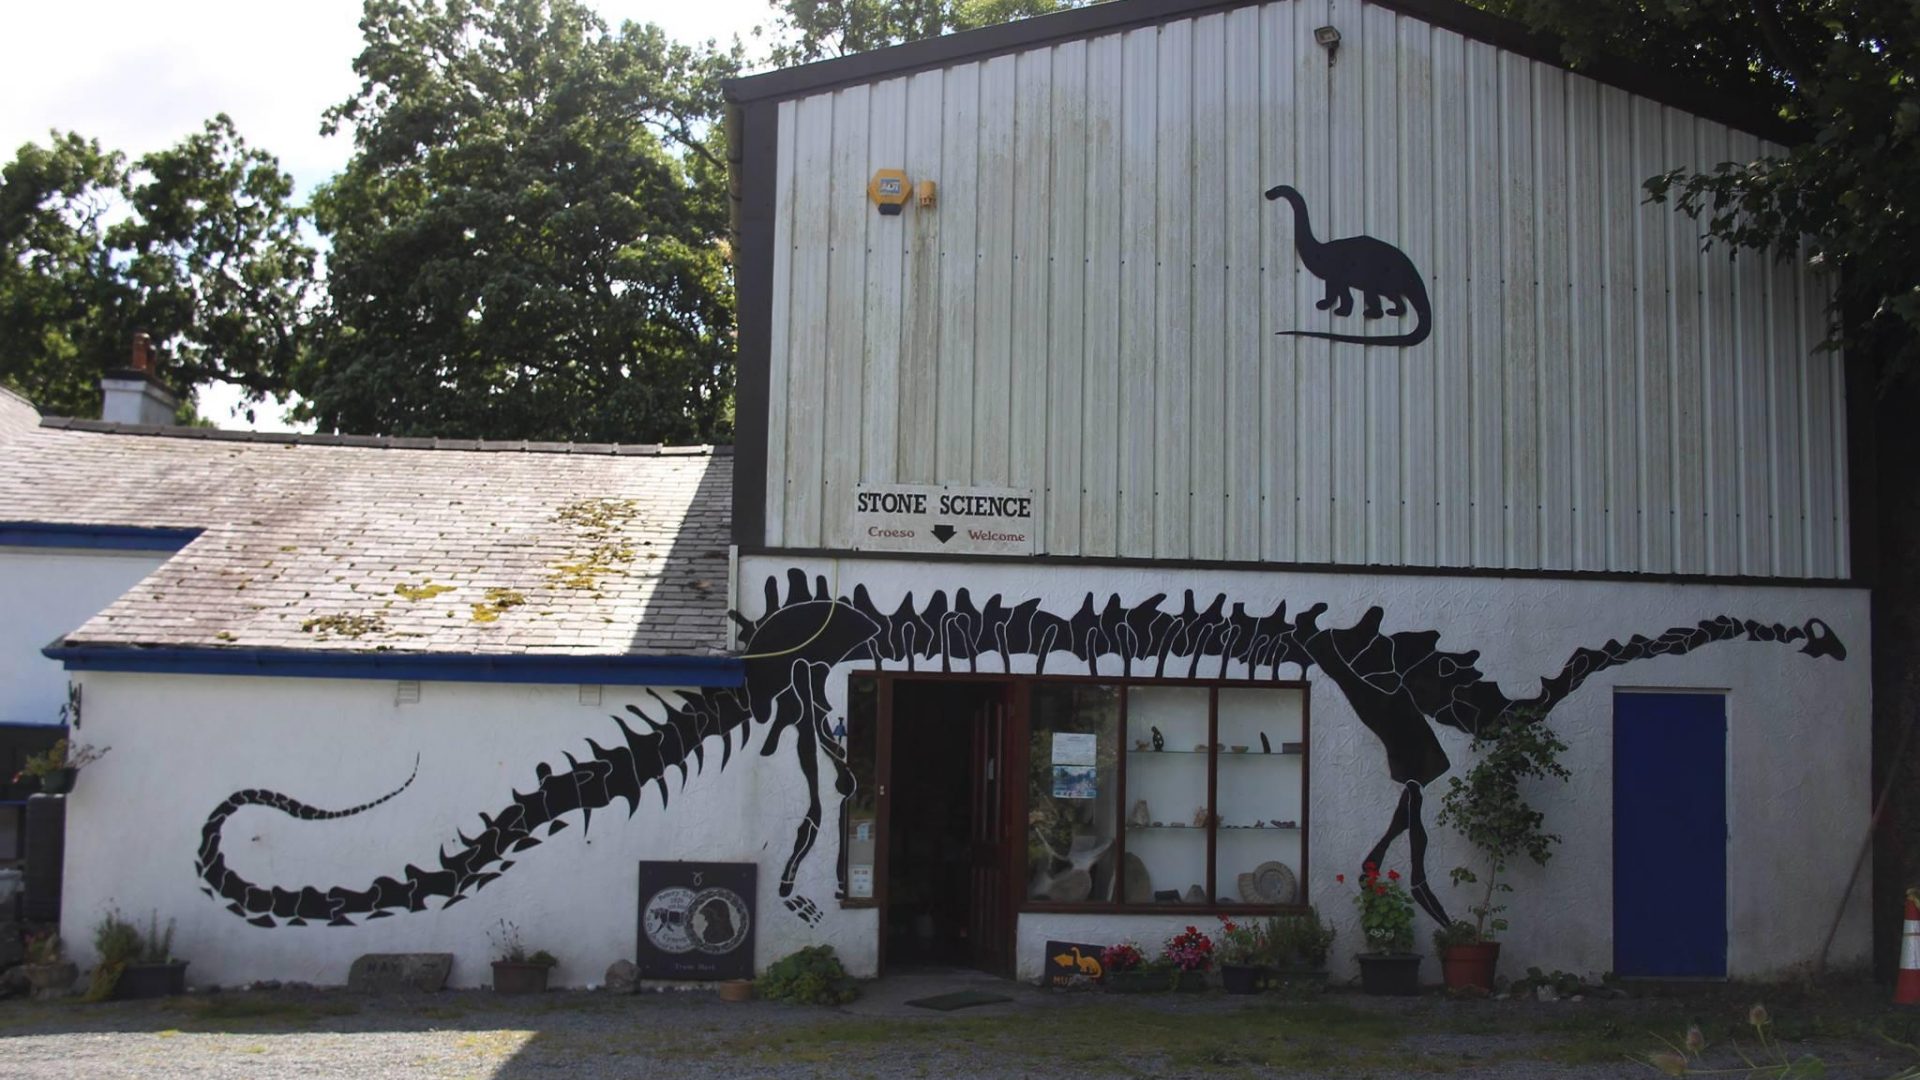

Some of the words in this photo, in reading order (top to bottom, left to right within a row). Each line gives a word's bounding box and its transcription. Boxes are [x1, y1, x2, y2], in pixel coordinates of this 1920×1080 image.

[858, 493, 926, 514] STONE
[940, 496, 1031, 517] SCIENCE
[868, 526, 915, 538] Croeso
[968, 530, 1025, 542] Welcome
